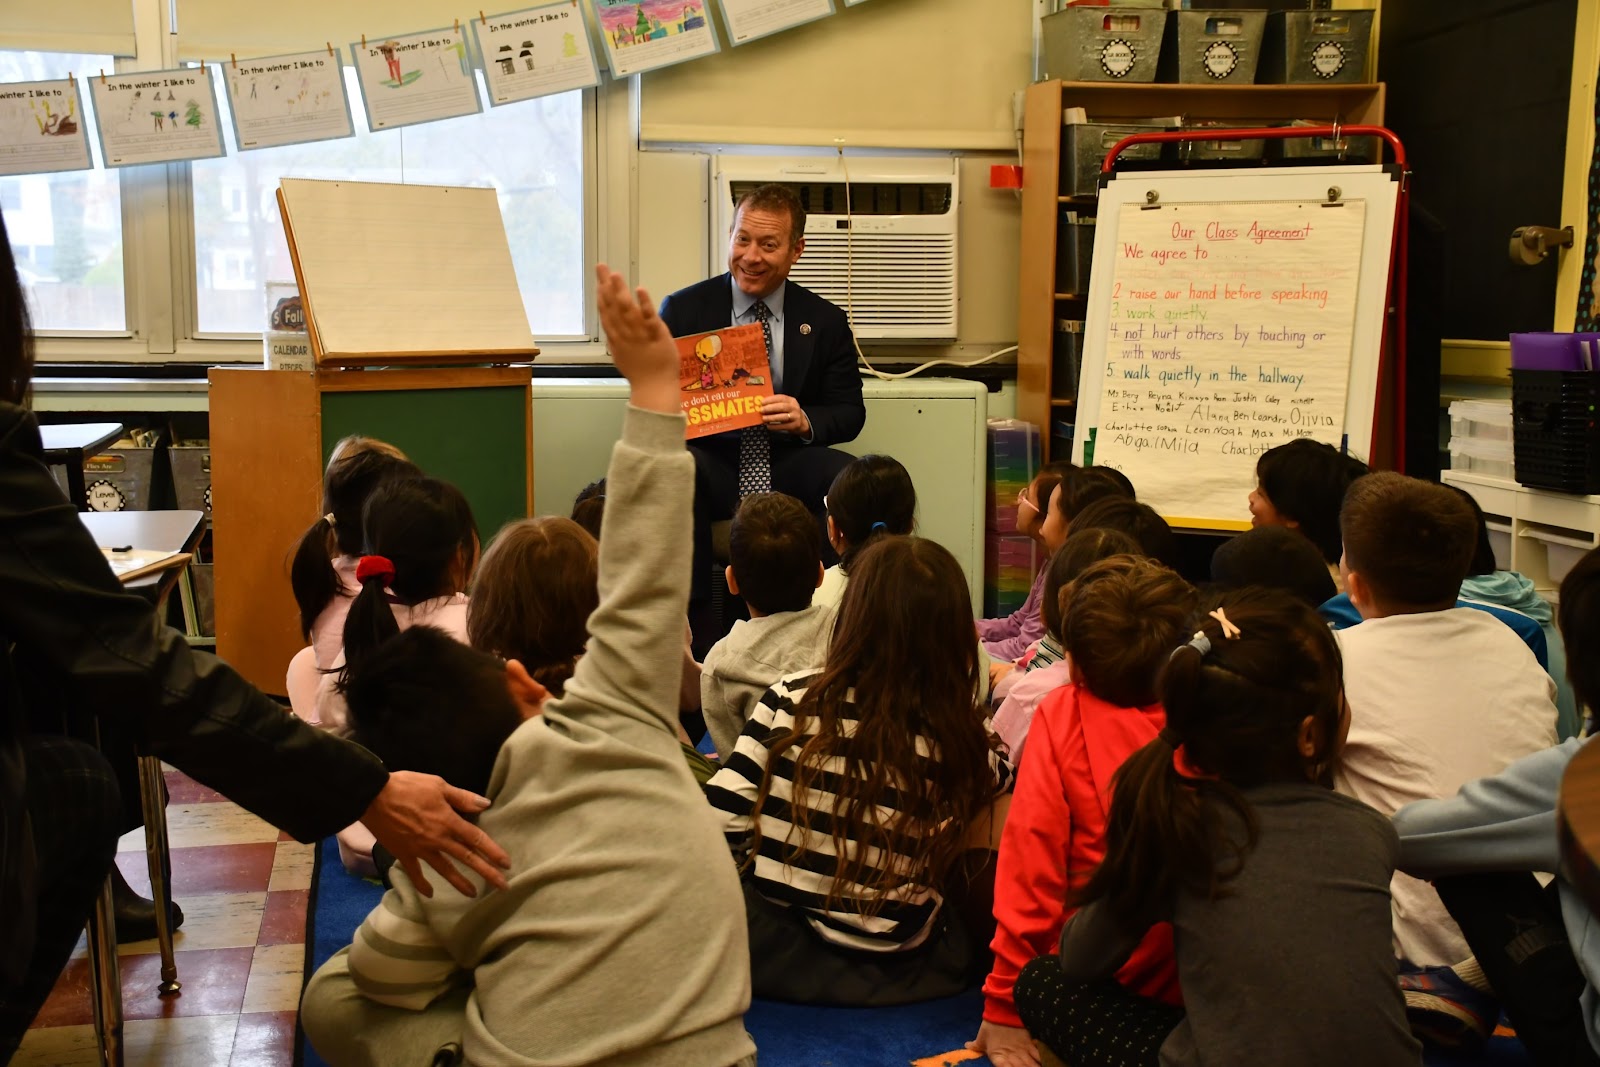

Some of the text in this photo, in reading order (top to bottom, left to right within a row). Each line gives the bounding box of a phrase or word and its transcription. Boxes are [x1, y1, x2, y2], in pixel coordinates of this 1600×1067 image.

[514, 17, 537, 27] winter
[545, 14, 559, 22] like
[369, 49, 378, 57] In
[395, 43, 419, 52] winter
[266, 64, 291, 72] winter
[135, 81, 161, 89] winter
[163, 79, 169, 87] I
[0, 91, 26, 99] winter
[1171, 220, 1314, 244] Our Class Agreement
[1124, 242, 1209, 266] We agree to
[1129, 287, 1157, 299] raise
[1164, 289, 1182, 299] our
[1189, 282, 1217, 300] hand
[1224, 282, 1262, 300] before
[1271, 282, 1328, 309] speaking
[285, 309, 303, 323] Fall
[1126, 304, 1156, 319] work
[1125, 322, 1146, 340] not
[1152, 323, 1180, 340] hurt
[1186, 324, 1224, 340] others
[1234, 323, 1250, 348] by
[1257, 325, 1306, 349] touching
[1312, 332, 1326, 341] or
[273, 345, 308, 356] CALENDAR
[1122, 344, 1144, 359] with
[1123, 364, 1151, 380] walk
[1158, 365, 1202, 388] quietly
[1209, 370, 1219, 381] in
[1228, 365, 1248, 381] the
[691, 394, 710, 406] don't
[711, 392, 725, 401] eat
[726, 390, 741, 398] our
[1122, 390, 1139, 403] Berg
[1148, 390, 1172, 402] Reyna
[1232, 391, 1257, 403] Justin
[686, 395, 765, 426] SSMATES
[1190, 404, 1230, 423] Alana
[1233, 411, 1249, 421] Ben
[1252, 411, 1287, 424] Leandro
[1105, 421, 1153, 432] Charlotte
[1185, 424, 1211, 435] Leon
[1213, 426, 1243, 436] Noah
[1251, 428, 1274, 438] Max
[1160, 436, 1199, 455] Mila
[1221, 441, 1270, 456] Charlott
